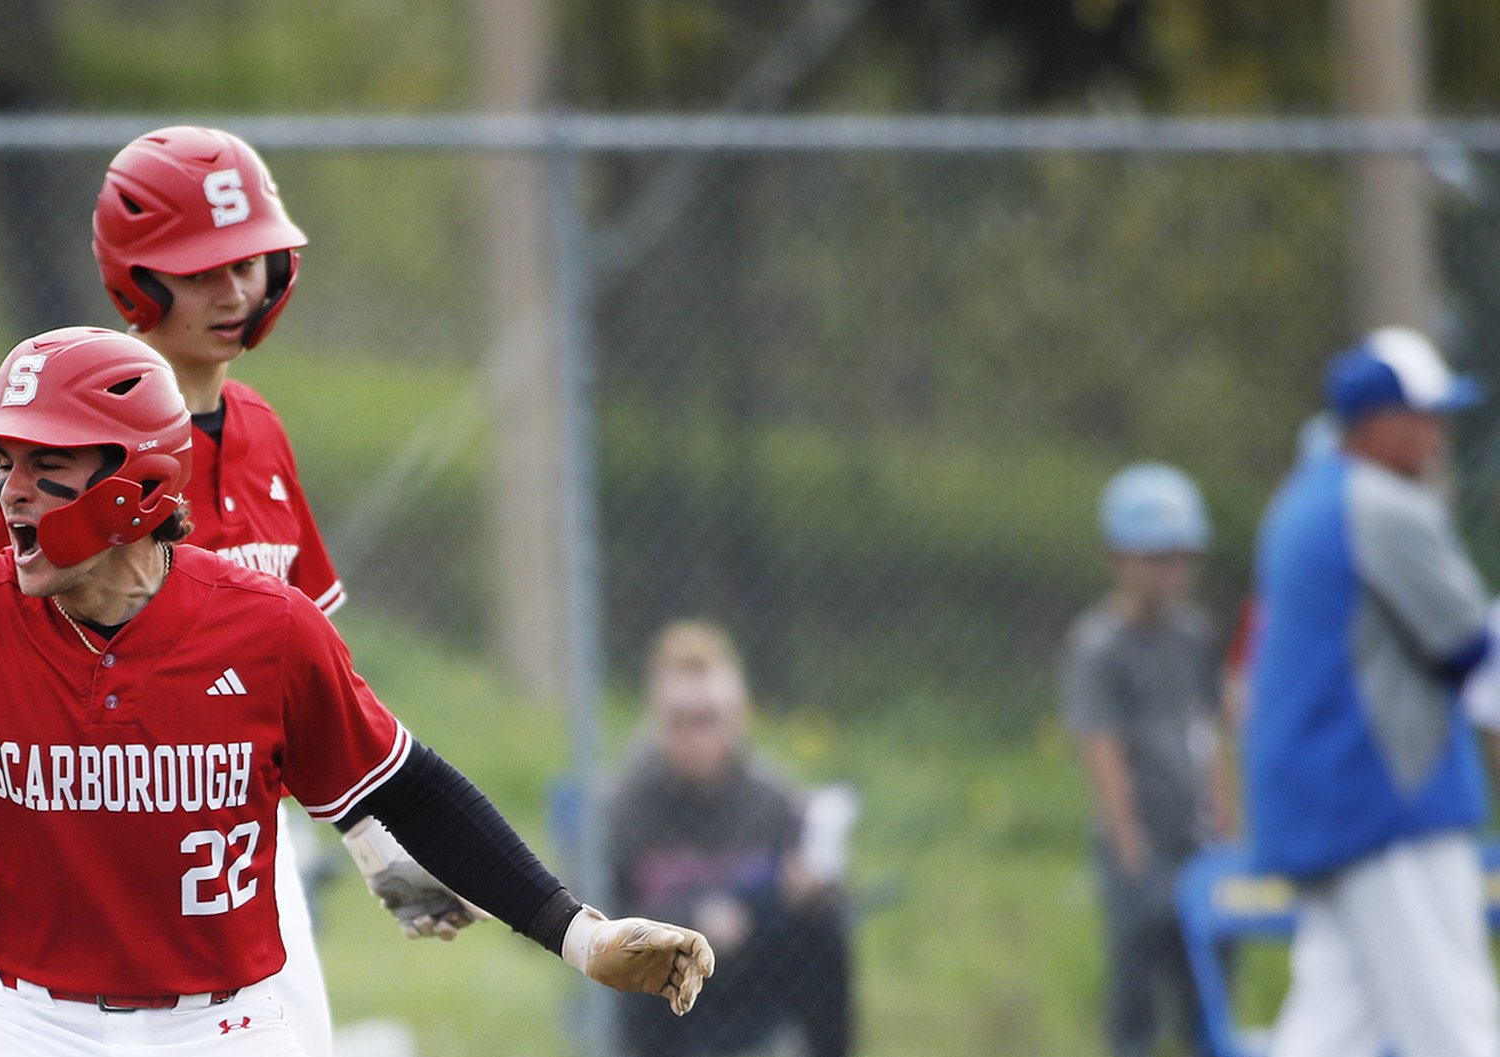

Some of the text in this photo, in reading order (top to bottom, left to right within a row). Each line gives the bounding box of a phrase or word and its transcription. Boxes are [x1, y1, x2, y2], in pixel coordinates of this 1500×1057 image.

[204, 169, 250, 228] S
[1, 354, 46, 407] S
[180, 821, 261, 916] 22
